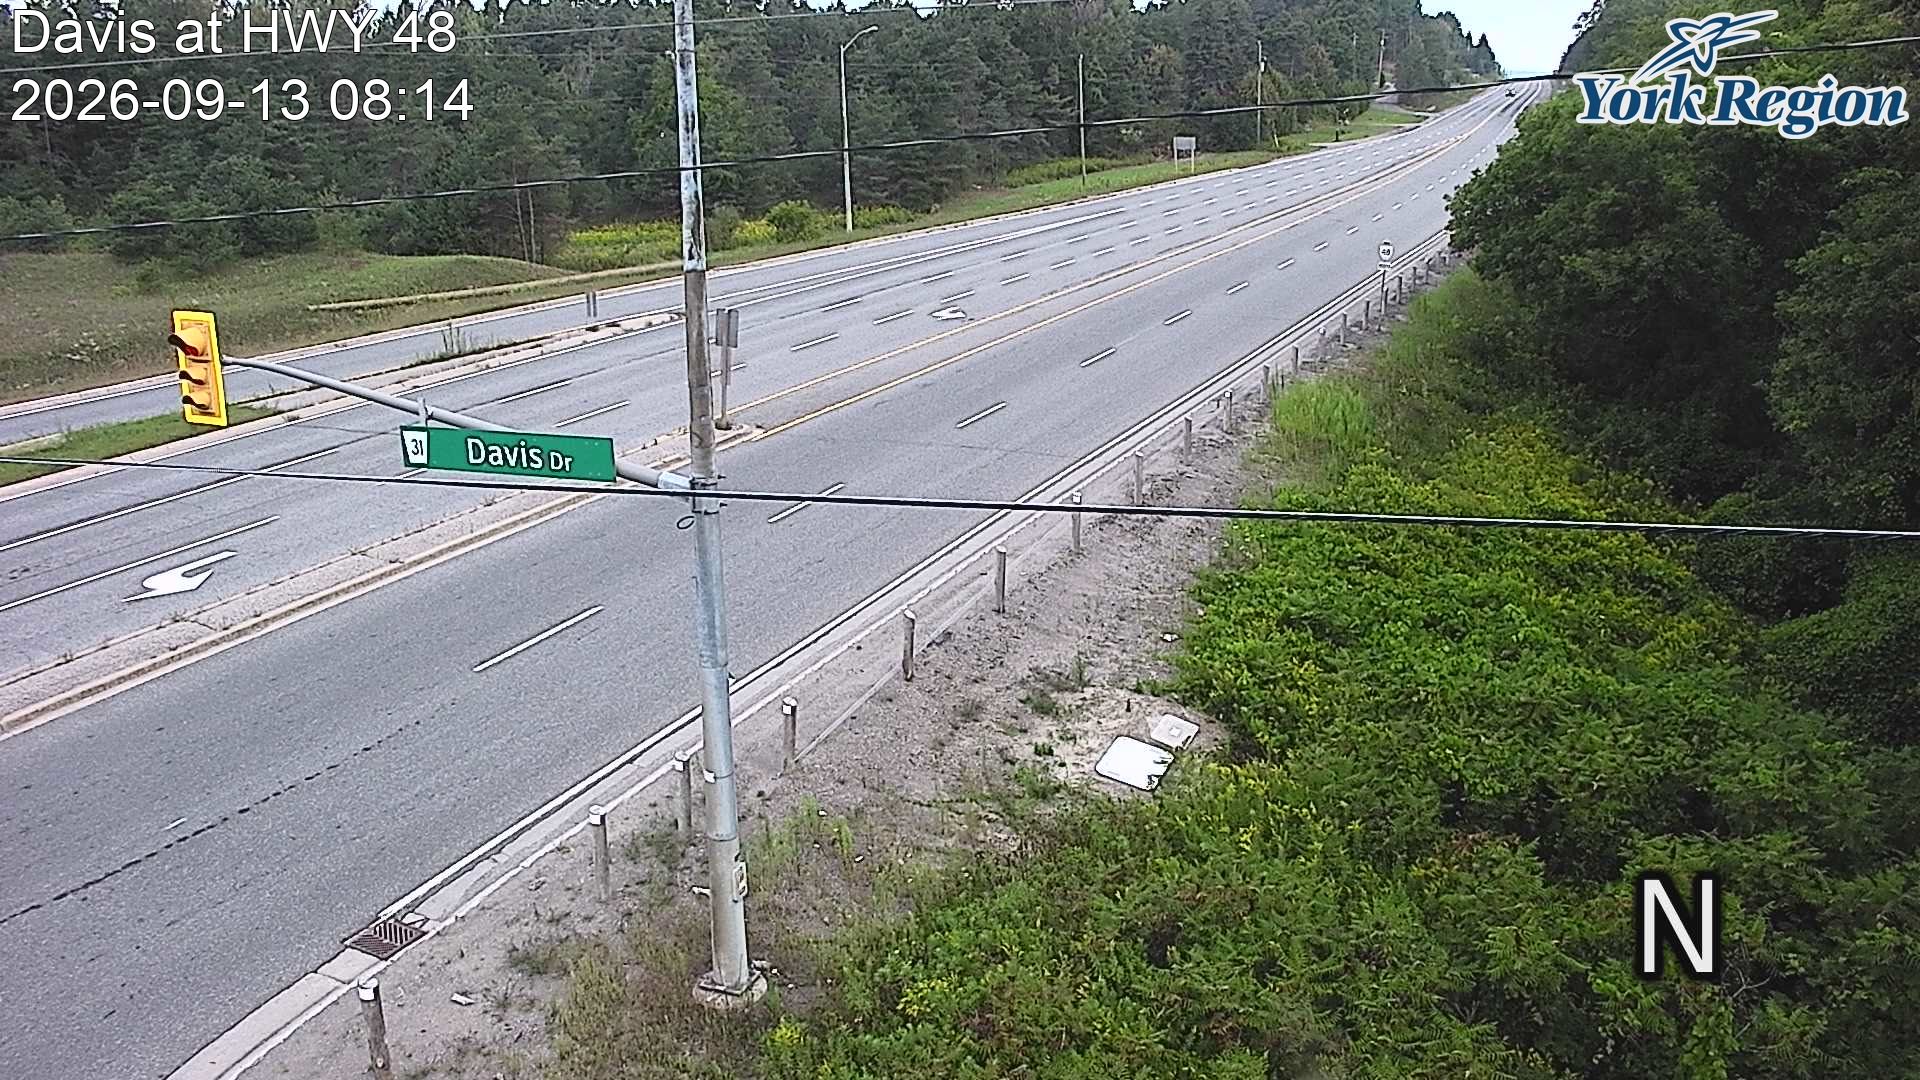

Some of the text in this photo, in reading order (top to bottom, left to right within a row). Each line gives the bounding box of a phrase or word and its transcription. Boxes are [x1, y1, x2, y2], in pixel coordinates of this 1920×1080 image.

[410, 438, 424, 457] 31
[466, 437, 573, 472] Davis Dr
